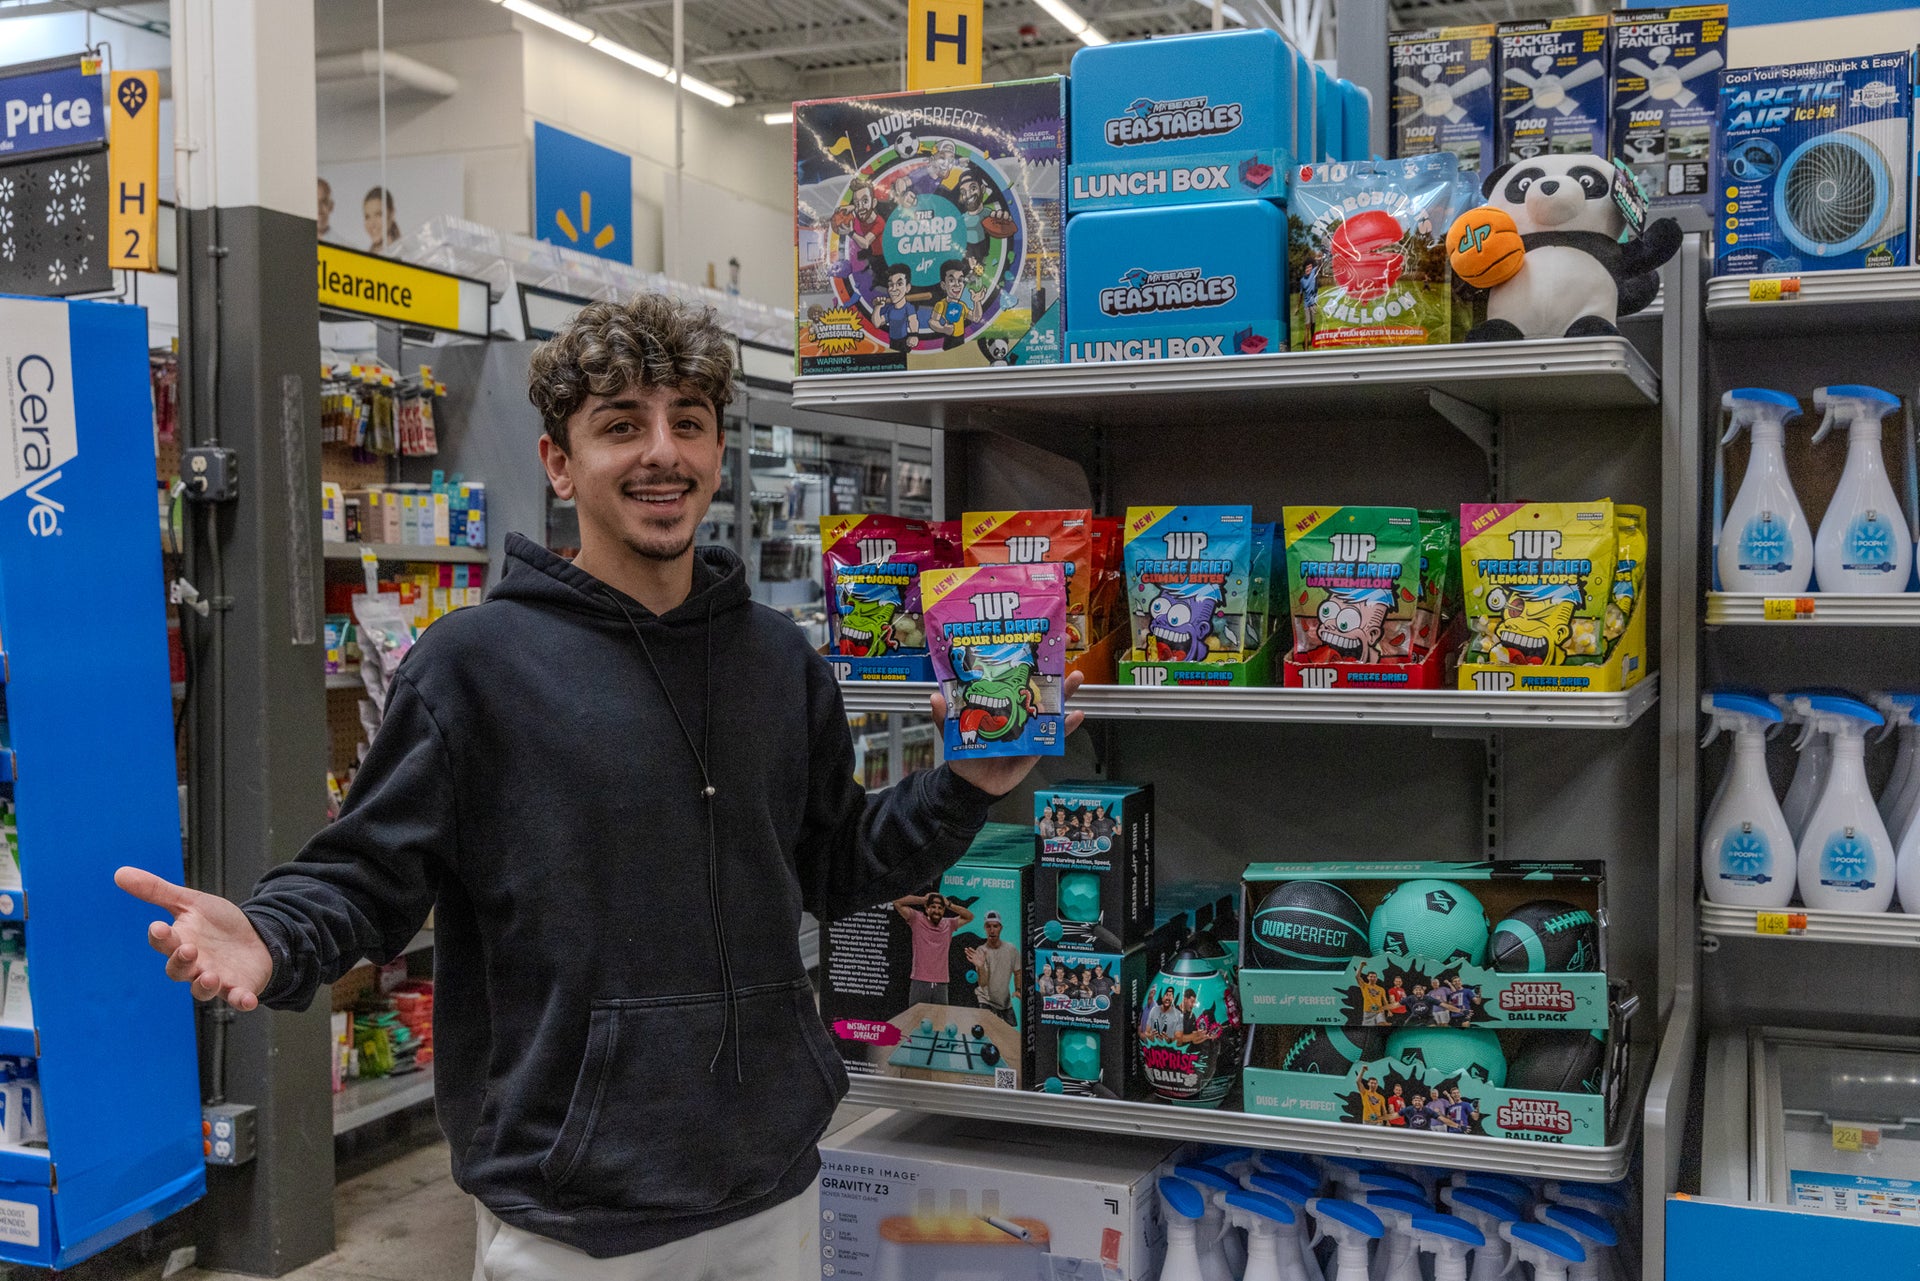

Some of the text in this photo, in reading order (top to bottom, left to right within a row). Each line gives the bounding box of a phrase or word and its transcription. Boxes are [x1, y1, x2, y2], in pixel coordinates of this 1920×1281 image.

[1636, 13, 1665, 21] HOWELL
[1519, 24, 1547, 32] HOWELL
[1619, 23, 1680, 37] SOCKET
[927, 11, 967, 65] H
[1503, 33, 1562, 47] SOCKET
[1619, 33, 1694, 48] FANLIGHT
[1393, 42, 1450, 56] SOCKET
[1503, 42, 1576, 58] FANLIGHT
[1393, 51, 1464, 67] FANLIGHT
[1726, 73, 1751, 84] Cool
[1754, 71, 1779, 81] Your
[1861, 61, 1870, 69] &
[1872, 56, 1904, 69] Easy!
[1728, 80, 1845, 110] ARCTIC
[5, 93, 91, 137] Price
[1106, 104, 1241, 142] FEASTABLES
[1630, 109, 1663, 121] 1000
[1727, 104, 1837, 130] AIR Ice Jet
[1405, 126, 1437, 137] 1000
[1515, 118, 1547, 130] 1000
[1514, 129, 1545, 137] LUMENS
[1317, 165, 1347, 182] 10
[1074, 165, 1230, 199] LUNCH BOX
[120, 182, 145, 215] H
[916, 210, 933, 220] THE
[892, 216, 957, 238] BOARD
[124, 229, 140, 258] 2
[897, 234, 952, 254] GAME
[1867, 255, 1892, 263] ENERGY
[318, 261, 413, 308] learance
[1101, 277, 1235, 311] FEASTABLES
[1323, 291, 1417, 324] BALLOON
[817, 331, 864, 339] CONSEQUENCES
[819, 323, 852, 332] WHEEL
[1070, 338, 1162, 363] LUNCH
[1167, 335, 1224, 358] BOX
[17, 354, 64, 537] CeraVe
[972, 516, 997, 536] NEW!
[1133, 510, 1156, 532] NEW!
[1296, 510, 1320, 532] NEW!
[1472, 508, 1501, 531] NEW!
[856, 539, 897, 564] 1UP
[1005, 537, 1050, 562] 1UP
[1164, 533, 1207, 559] 1UP
[1330, 534, 1376, 561] 1UP
[1509, 531, 1562, 559] 1UP
[879, 564, 918, 575] DRIED
[1136, 561, 1232, 575] FREEZE DRIED
[1301, 562, 1402, 578] FREEZE DRIED
[1478, 560, 1591, 577] FREEZE DRIED
[865, 576, 910, 585] WORMS
[933, 572, 959, 595] NEW!
[1141, 574, 1225, 583] GUMMY BITES
[1307, 577, 1393, 588] WATERMELON
[1490, 575, 1577, 585] LEMON TOPS
[969, 592, 1019, 620] 1UP
[943, 618, 1049, 638] FREEZE DRIED
[953, 633, 1042, 647] SOUR WORMS
[1131, 667, 1167, 685] 1UP
[1174, 671, 1233, 680] FREEZE DRIED
[1298, 668, 1338, 688] 1UP
[1347, 673, 1408, 682] FREEZE DRIED
[1472, 672, 1515, 691] 1UP
[1522, 677, 1590, 687] FREEZE DRIED
[1045, 838, 1097, 854] BLITZBALL
[944, 876, 1015, 889] DUDE PERFECT
[1513, 984, 1559, 995] MINI
[1044, 998, 1095, 1010] BLITZBALL
[1253, 995, 1336, 1006] DUDE PERFECT
[1502, 992, 1573, 1009] SPORTS
[1508, 1013, 1567, 1022] BALL PACK
[847, 1023, 871, 1031] INSTANT
[1143, 1047, 1199, 1075] SURPRISE
[1153, 1068, 1184, 1083] BALL
[1256, 1096, 1336, 1112] DUDE PERFECT
[1510, 1100, 1557, 1113] MINI
[1500, 1108, 1570, 1131] SPORTS
[1505, 1132, 1564, 1144] BALL PACK
[821, 1162, 916, 1181] SHARPER IMAGE
[822, 1178, 889, 1195] GRAVITY Z3
